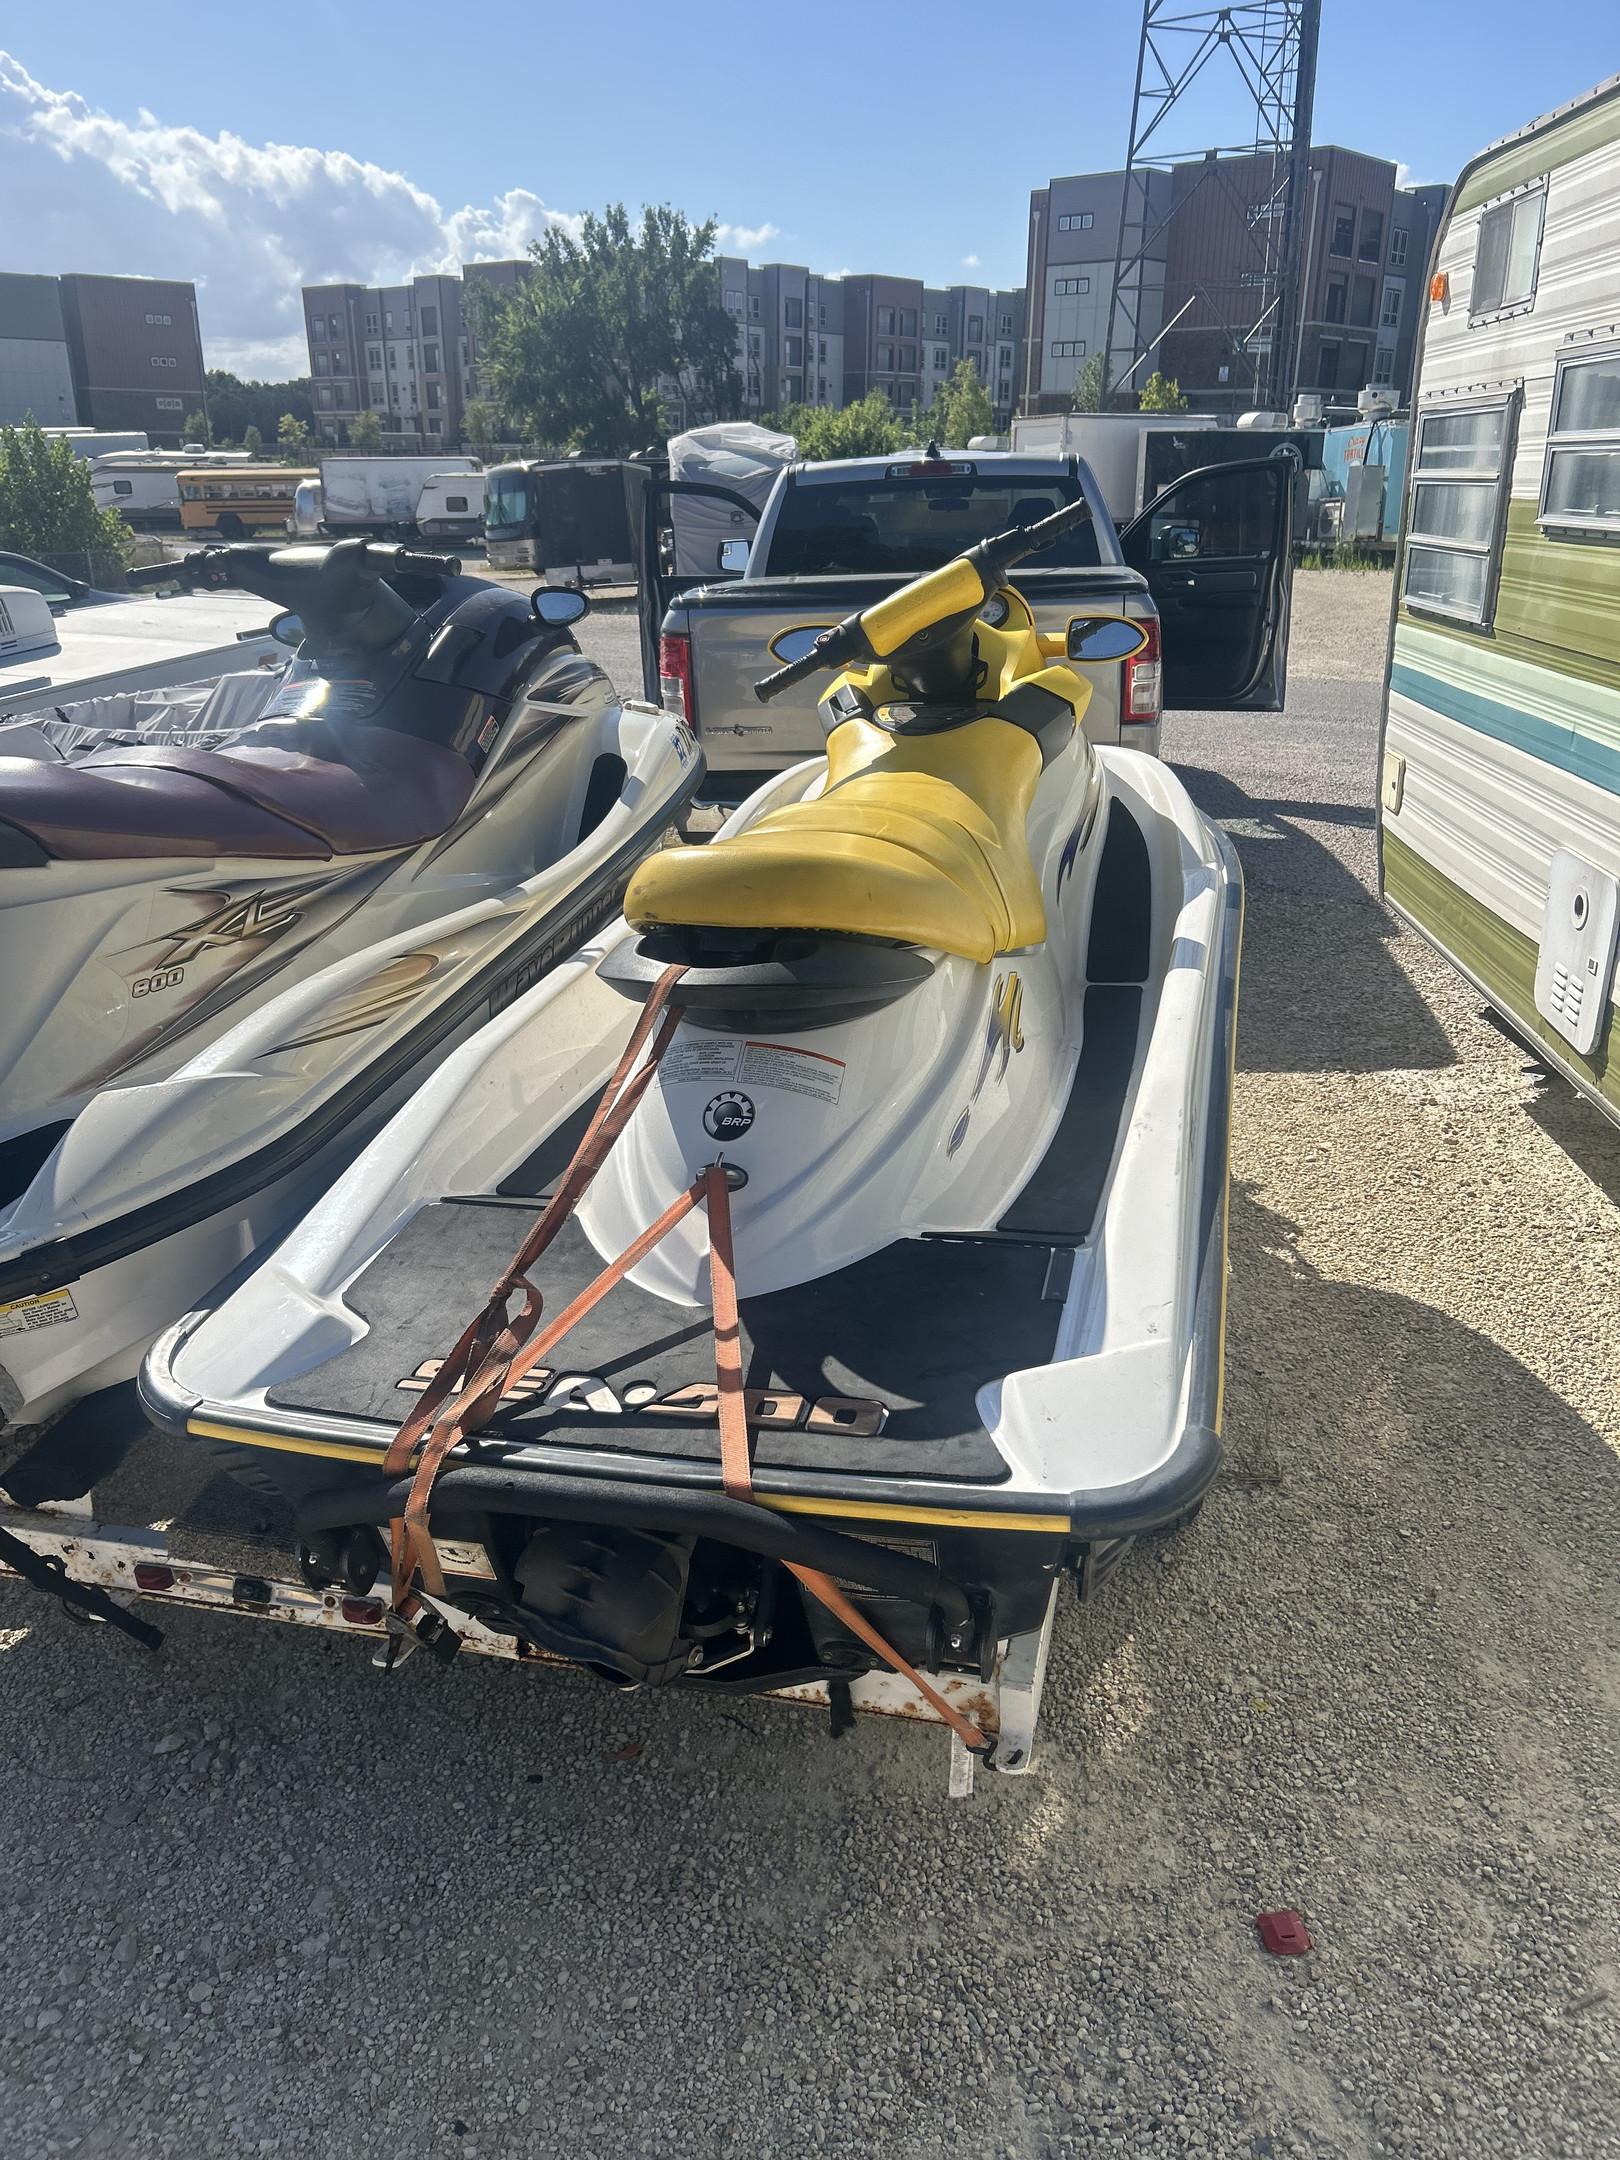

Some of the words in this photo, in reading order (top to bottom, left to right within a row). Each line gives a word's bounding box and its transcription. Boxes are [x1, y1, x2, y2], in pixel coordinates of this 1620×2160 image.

[131, 966, 185, 999] 800
[721, 1116, 752, 1128] BRP
[10, 1299, 40, 1310] CAUTION
